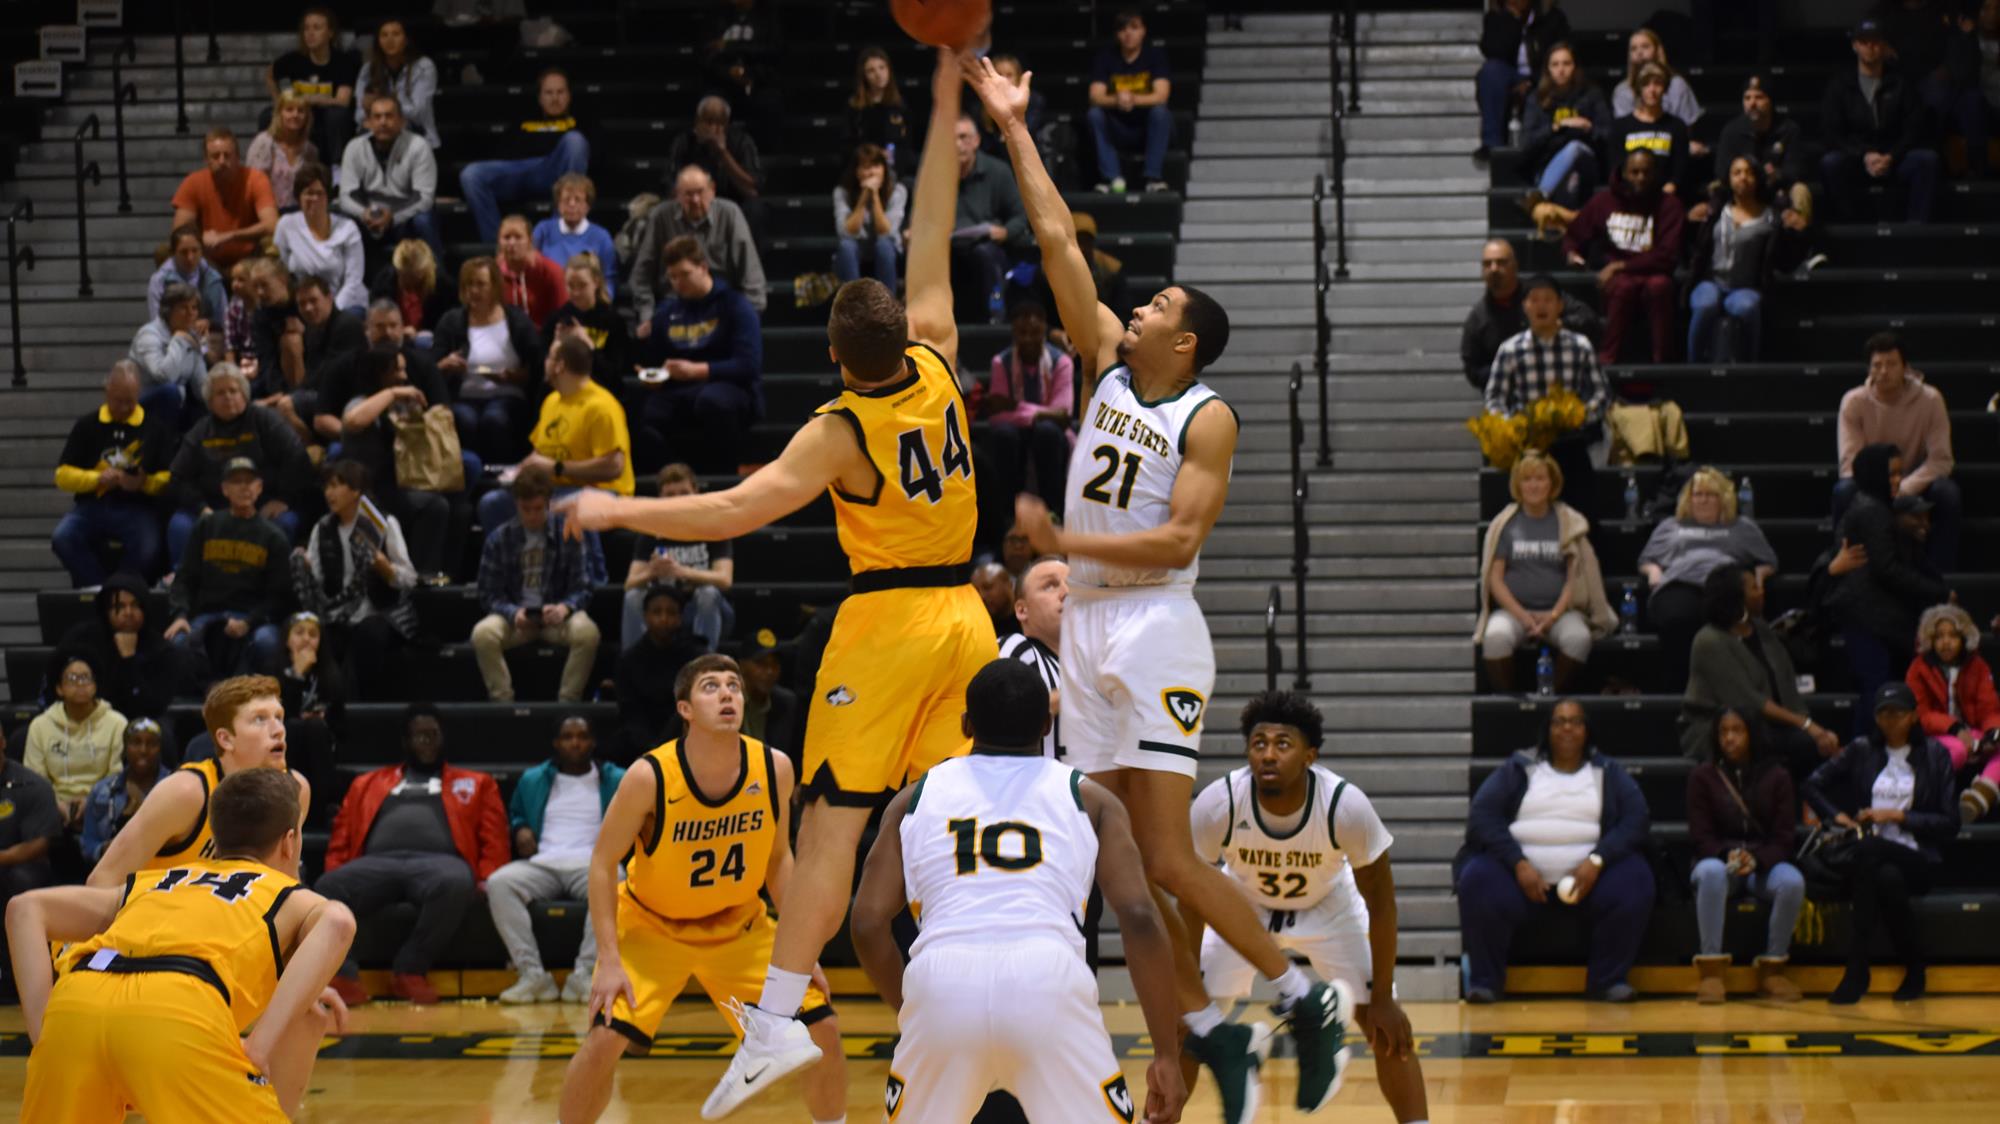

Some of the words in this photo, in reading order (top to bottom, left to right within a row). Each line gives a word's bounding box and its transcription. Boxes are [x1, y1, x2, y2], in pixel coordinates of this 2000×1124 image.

[898, 399, 972, 505] 44
[1129, 418, 1170, 459] STATE
[1082, 444, 1142, 511] 21
[690, 843, 746, 888] 24
[947, 815, 1044, 880] 10
[1238, 847, 1282, 868] WAYNE
[1286, 850, 1323, 868] STATE
[152, 868, 263, 904] 14
[1257, 871, 1309, 900] 32
